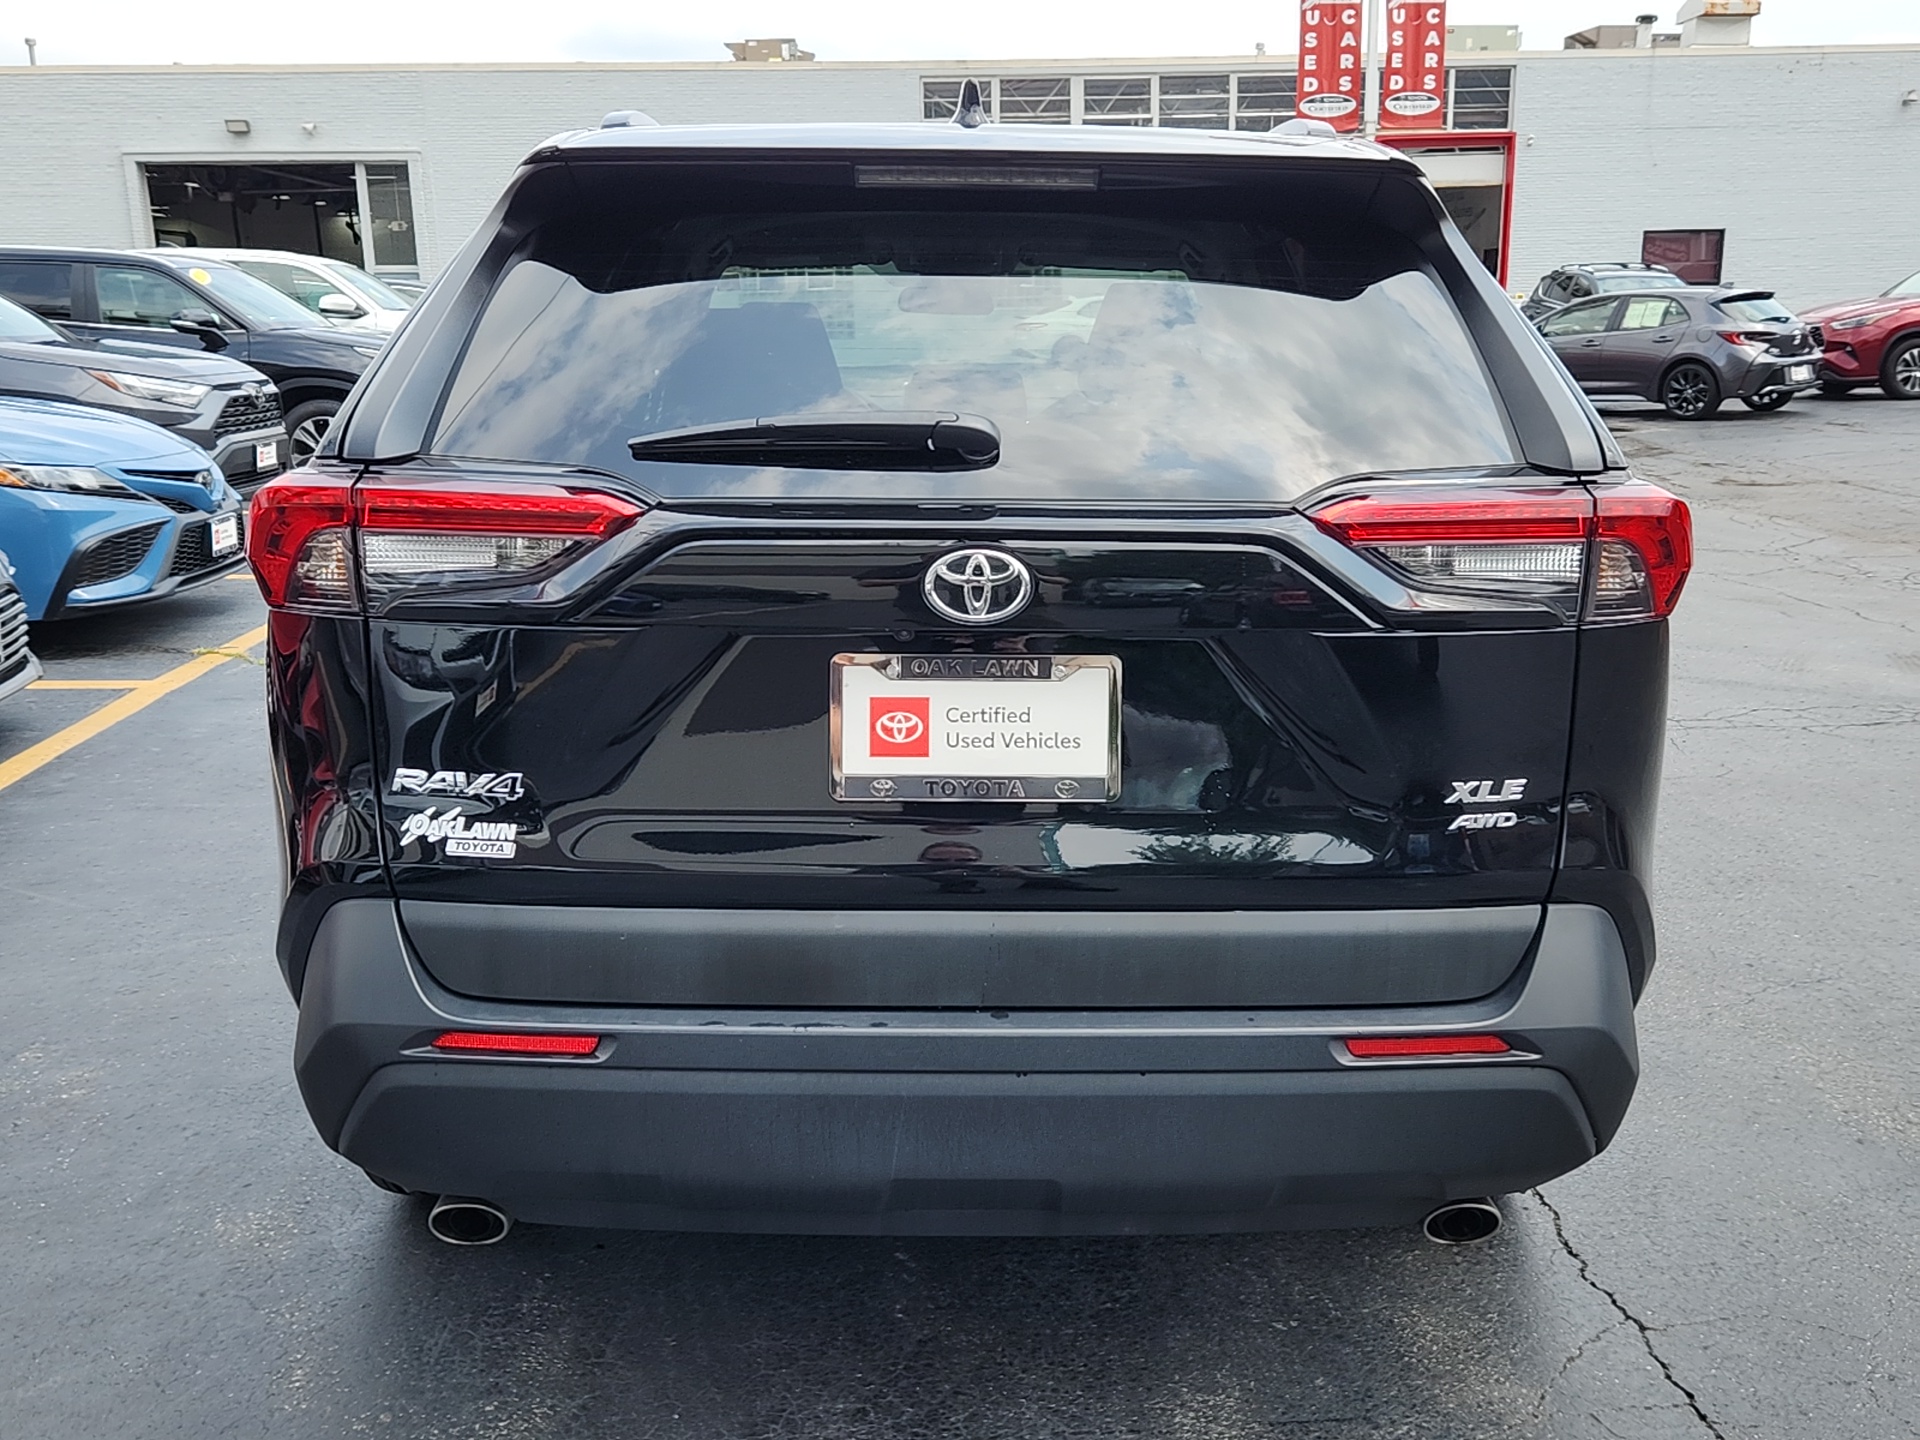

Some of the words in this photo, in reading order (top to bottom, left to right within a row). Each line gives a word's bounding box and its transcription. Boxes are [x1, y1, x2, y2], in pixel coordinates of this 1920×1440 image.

[1303, 9, 1320, 92] USED
[1338, 8, 1357, 91] CARS
[1389, 8, 1406, 90] USED
[1423, 8, 1441, 90] CARS
[911, 658, 963, 676] OAK
[970, 659, 1039, 677] LAWN
[946, 707, 1031, 723] Certified
[946, 732, 995, 749] Used
[1001, 732, 1081, 749] Vehicles
[391, 768, 525, 800] RAV4
[923, 779, 1025, 798] TOYOTA
[1443, 778, 1528, 804] XLE
[1446, 811, 1518, 830] AWD
[455, 841, 505, 853] TOYOTA
